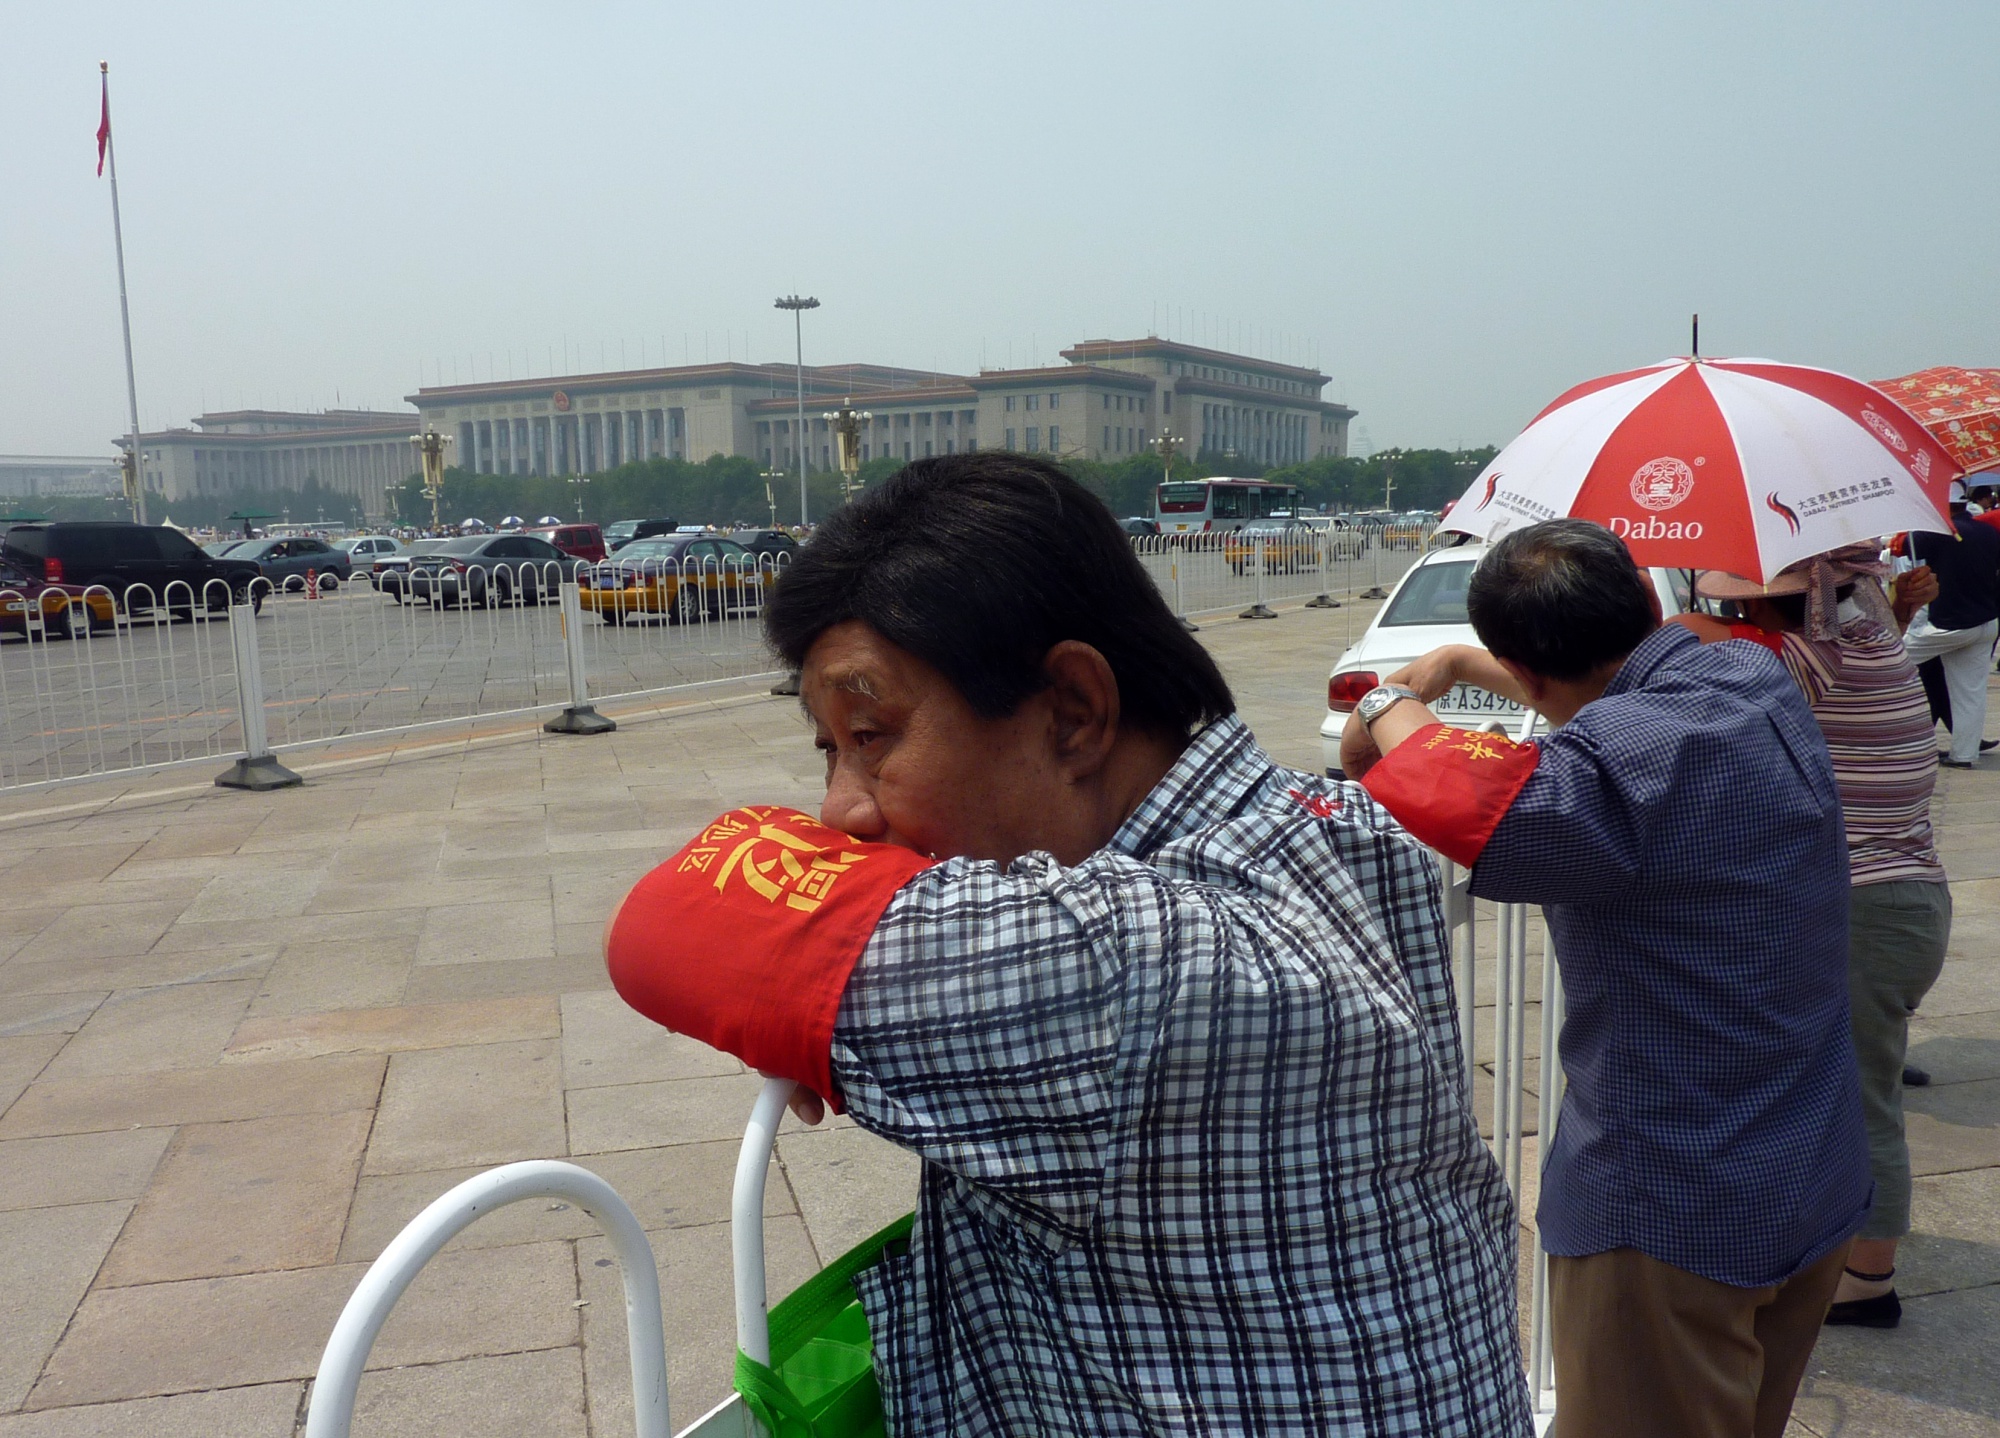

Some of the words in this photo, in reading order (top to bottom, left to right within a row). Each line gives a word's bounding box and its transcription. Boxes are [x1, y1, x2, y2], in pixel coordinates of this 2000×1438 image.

[1803, 506, 1827, 518] DABAO
[1829, 496, 1860, 510] NUTRIENT
[1862, 488, 1895, 501] SHAMPOO
[1609, 515, 1703, 540] Dabao
